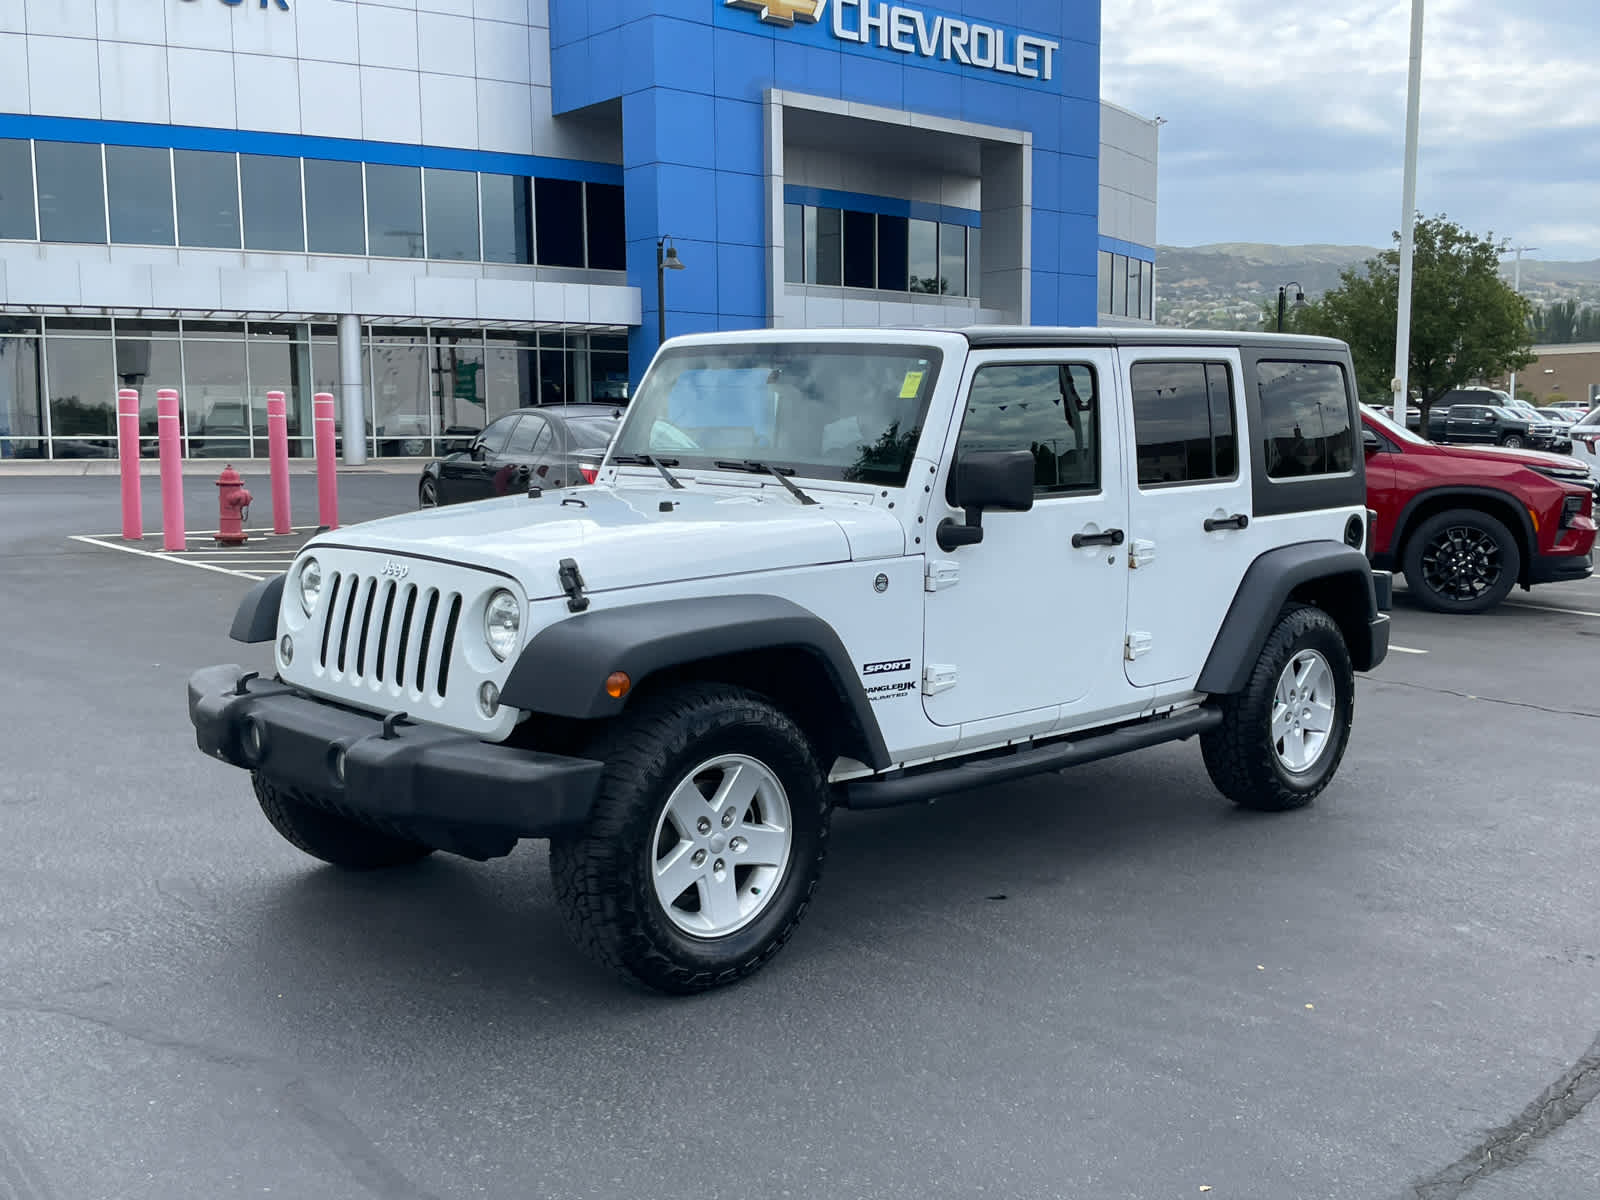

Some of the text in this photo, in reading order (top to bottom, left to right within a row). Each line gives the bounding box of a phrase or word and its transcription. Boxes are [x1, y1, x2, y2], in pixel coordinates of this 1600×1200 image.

[832, 0, 1060, 81] CHEVROLET
[381, 560, 409, 581] Jeep
[863, 660, 911, 674] SPORT
[867, 692, 909, 701] NLIMITED
